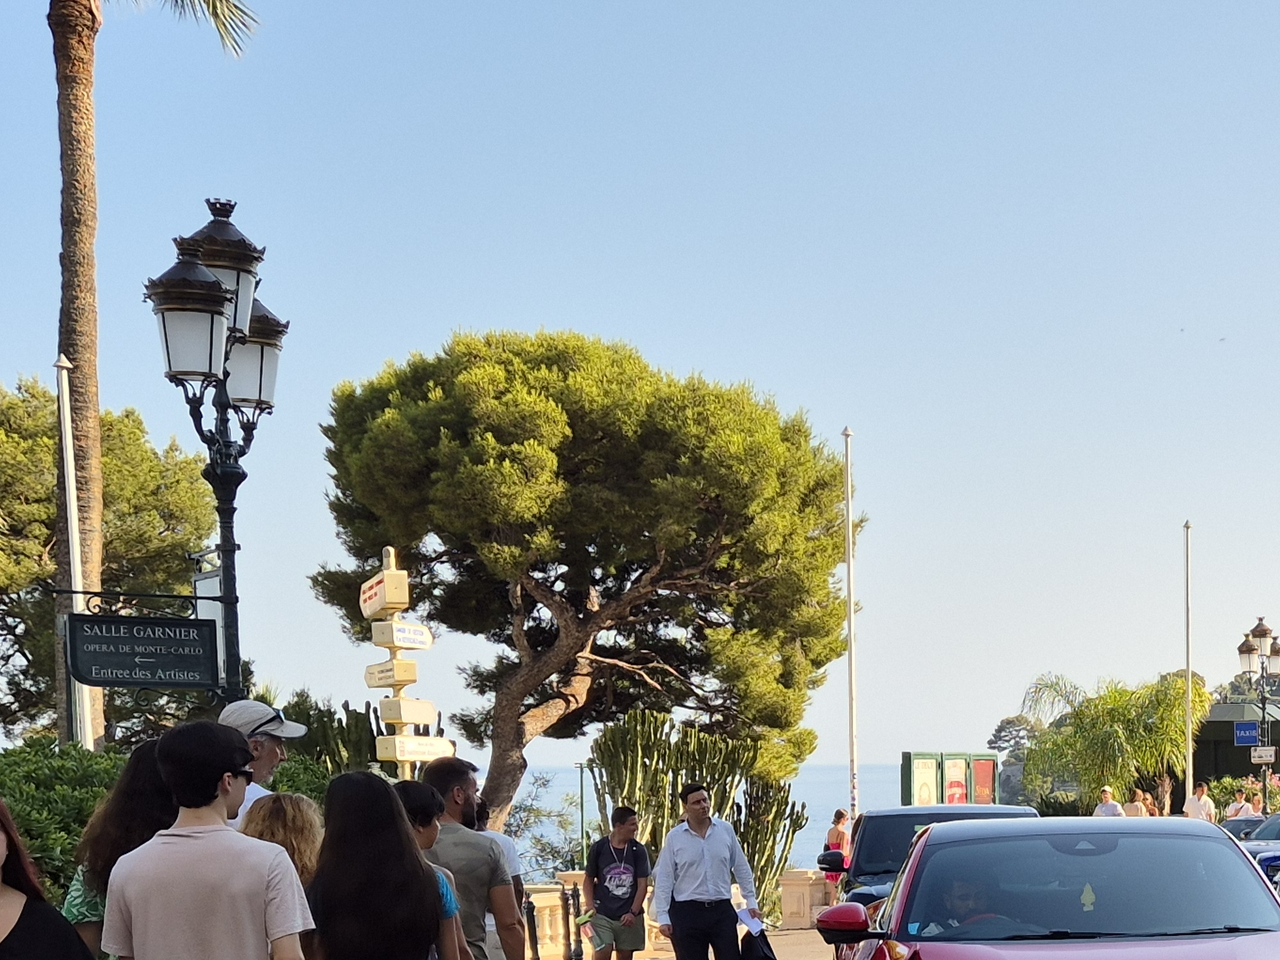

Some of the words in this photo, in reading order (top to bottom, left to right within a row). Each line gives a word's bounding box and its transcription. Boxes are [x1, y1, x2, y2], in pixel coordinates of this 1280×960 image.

[83, 624, 129, 637] SALLE
[133, 626, 199, 640] GARNIER
[83, 643, 116, 652] OPERA
[118, 644, 132, 653] DE
[134, 645, 203, 655] MONTE-CARLO
[92, 666, 129, 678] Entree
[132, 667, 151, 679] des
[155, 668, 200, 680] Artistes
